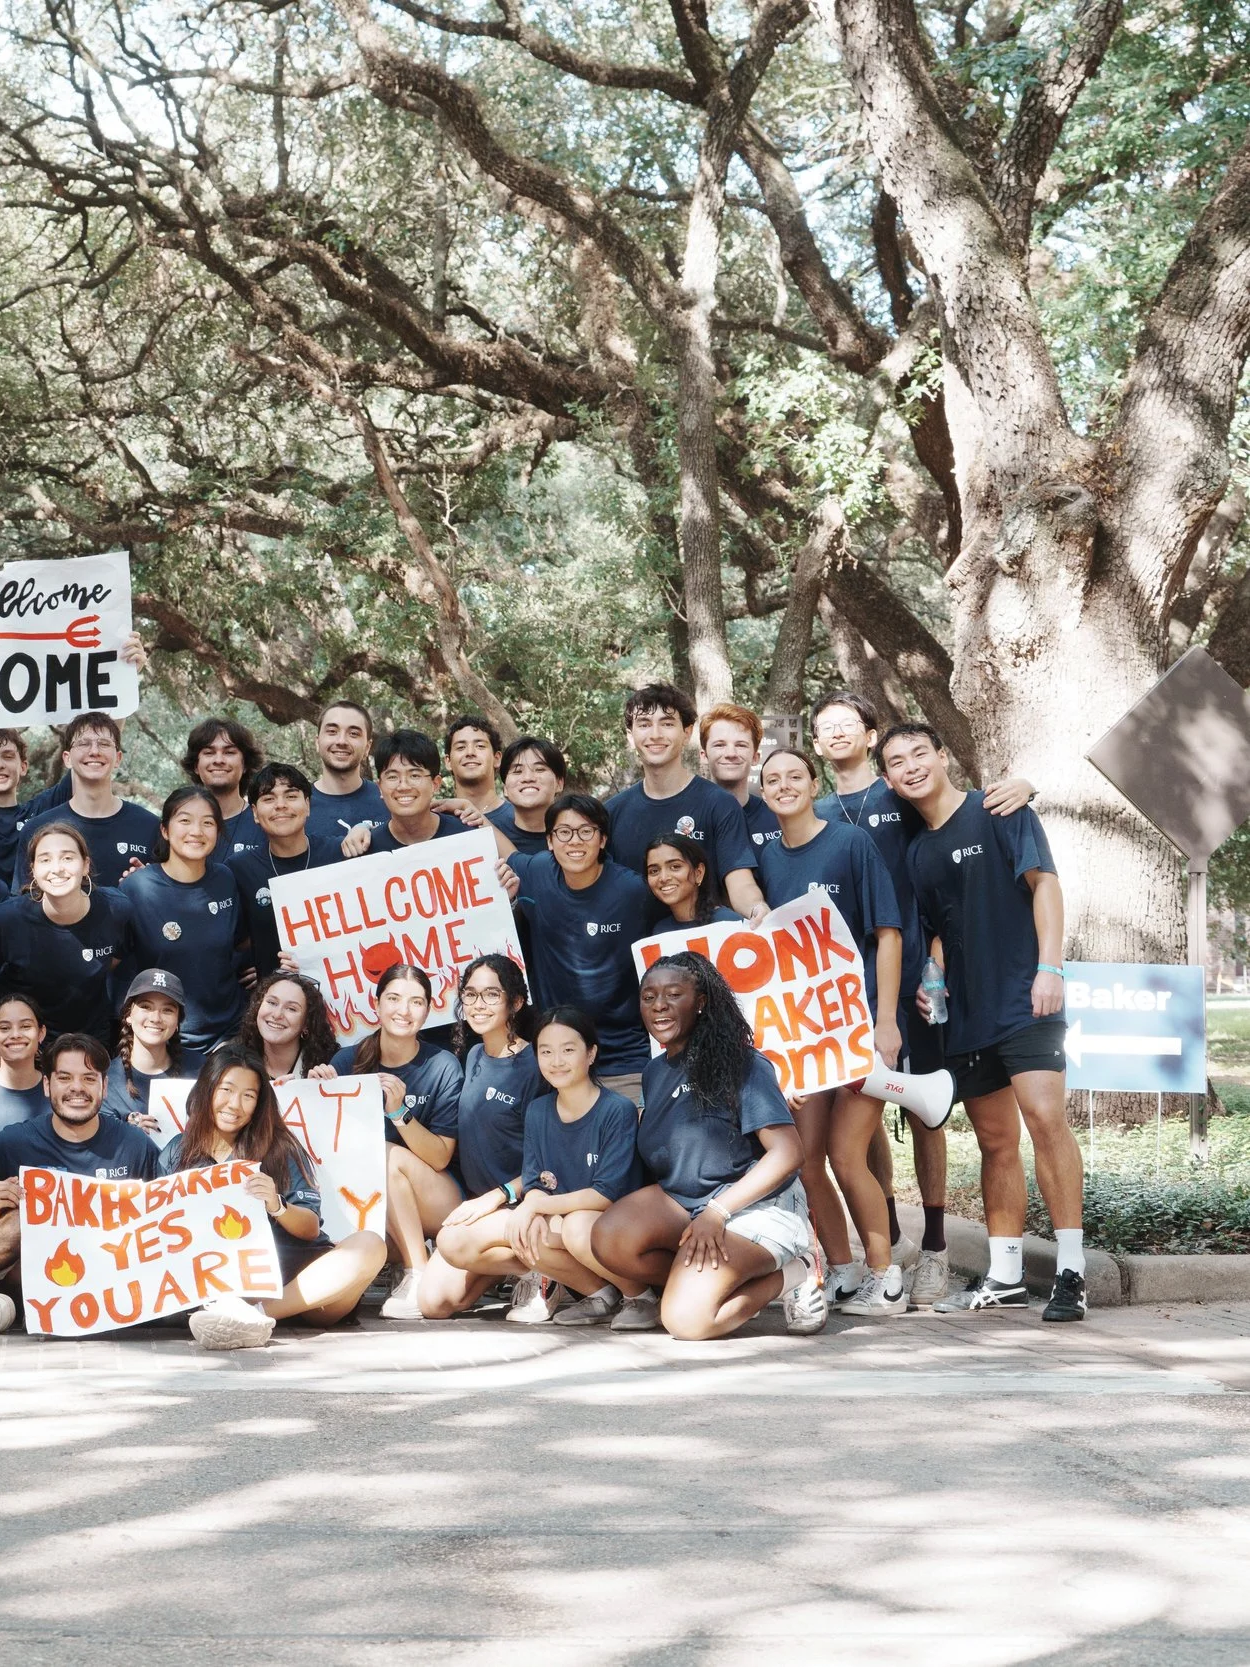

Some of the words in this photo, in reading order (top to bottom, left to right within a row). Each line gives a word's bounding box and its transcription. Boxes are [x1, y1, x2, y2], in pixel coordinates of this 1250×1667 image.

[881, 812, 901, 823] RICE
[765, 829, 782, 841] RICE
[130, 843, 147, 854] RICE
[962, 844, 983, 858] RICE
[219, 898, 233, 910] RICE
[281, 856, 494, 947] HELLCOME
[600, 923, 622, 934] RICE
[95, 946, 114, 958] RICE
[1066, 981, 1172, 1011] Baker
[753, 973, 867, 1049] AKER
[885, 1082, 904, 1094] PYLE
[495, 1090, 516, 1105] RICE
[110, 1166, 128, 1178] RICE
[23, 1168, 142, 1231] BAKER
[145, 1160, 261, 1214] BAKER
[100, 1209, 193, 1271] YES
[25, 1280, 142, 1333] YOU
[154, 1249, 277, 1314] ARE
